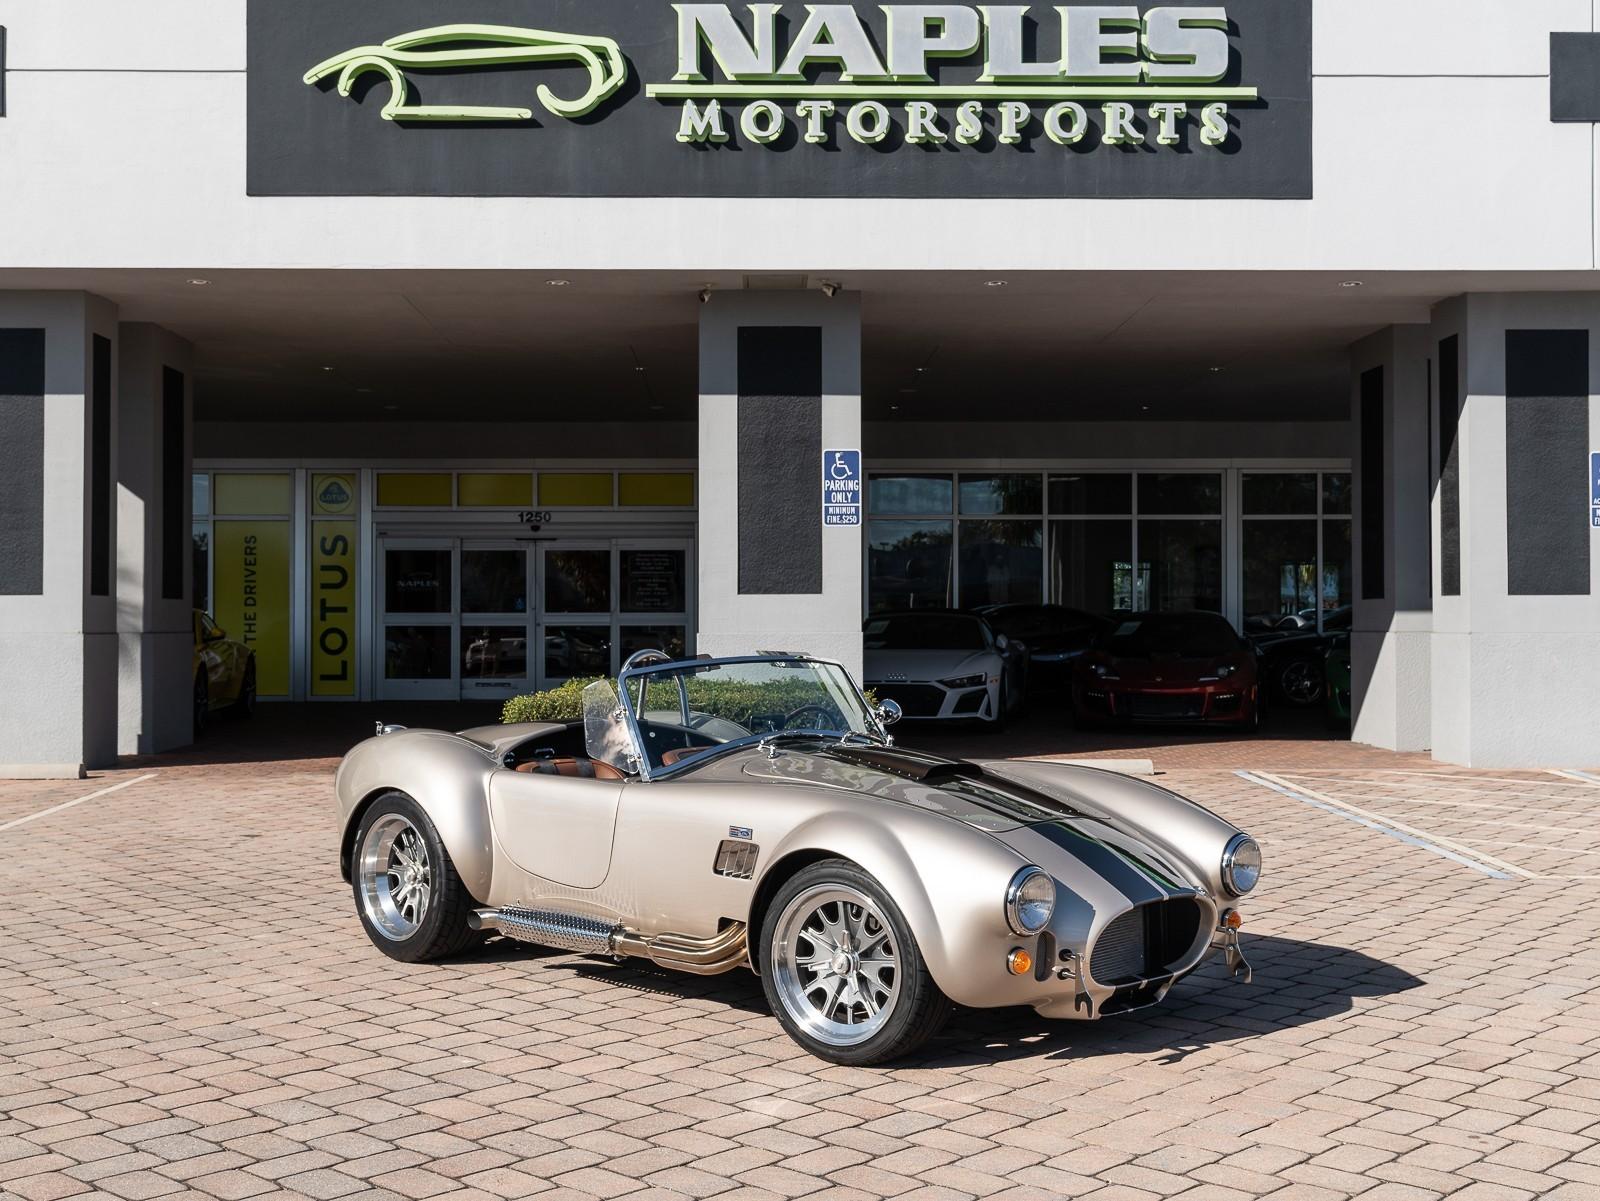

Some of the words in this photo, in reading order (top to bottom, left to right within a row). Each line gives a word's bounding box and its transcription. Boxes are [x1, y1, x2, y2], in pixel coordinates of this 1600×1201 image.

[671, 3, 1229, 83] NAPLES
[676, 99, 1230, 146] MOTORSPORTS
[825, 480, 859, 491] PARKING
[831, 492, 853, 503] ONLY
[518, 511, 552, 523] 1250
[828, 506, 856, 514] MINIMUM
[244, 535, 257, 607] DRIVERS
[320, 534, 348, 681] LOTUS
[244, 612, 257, 644] THE
